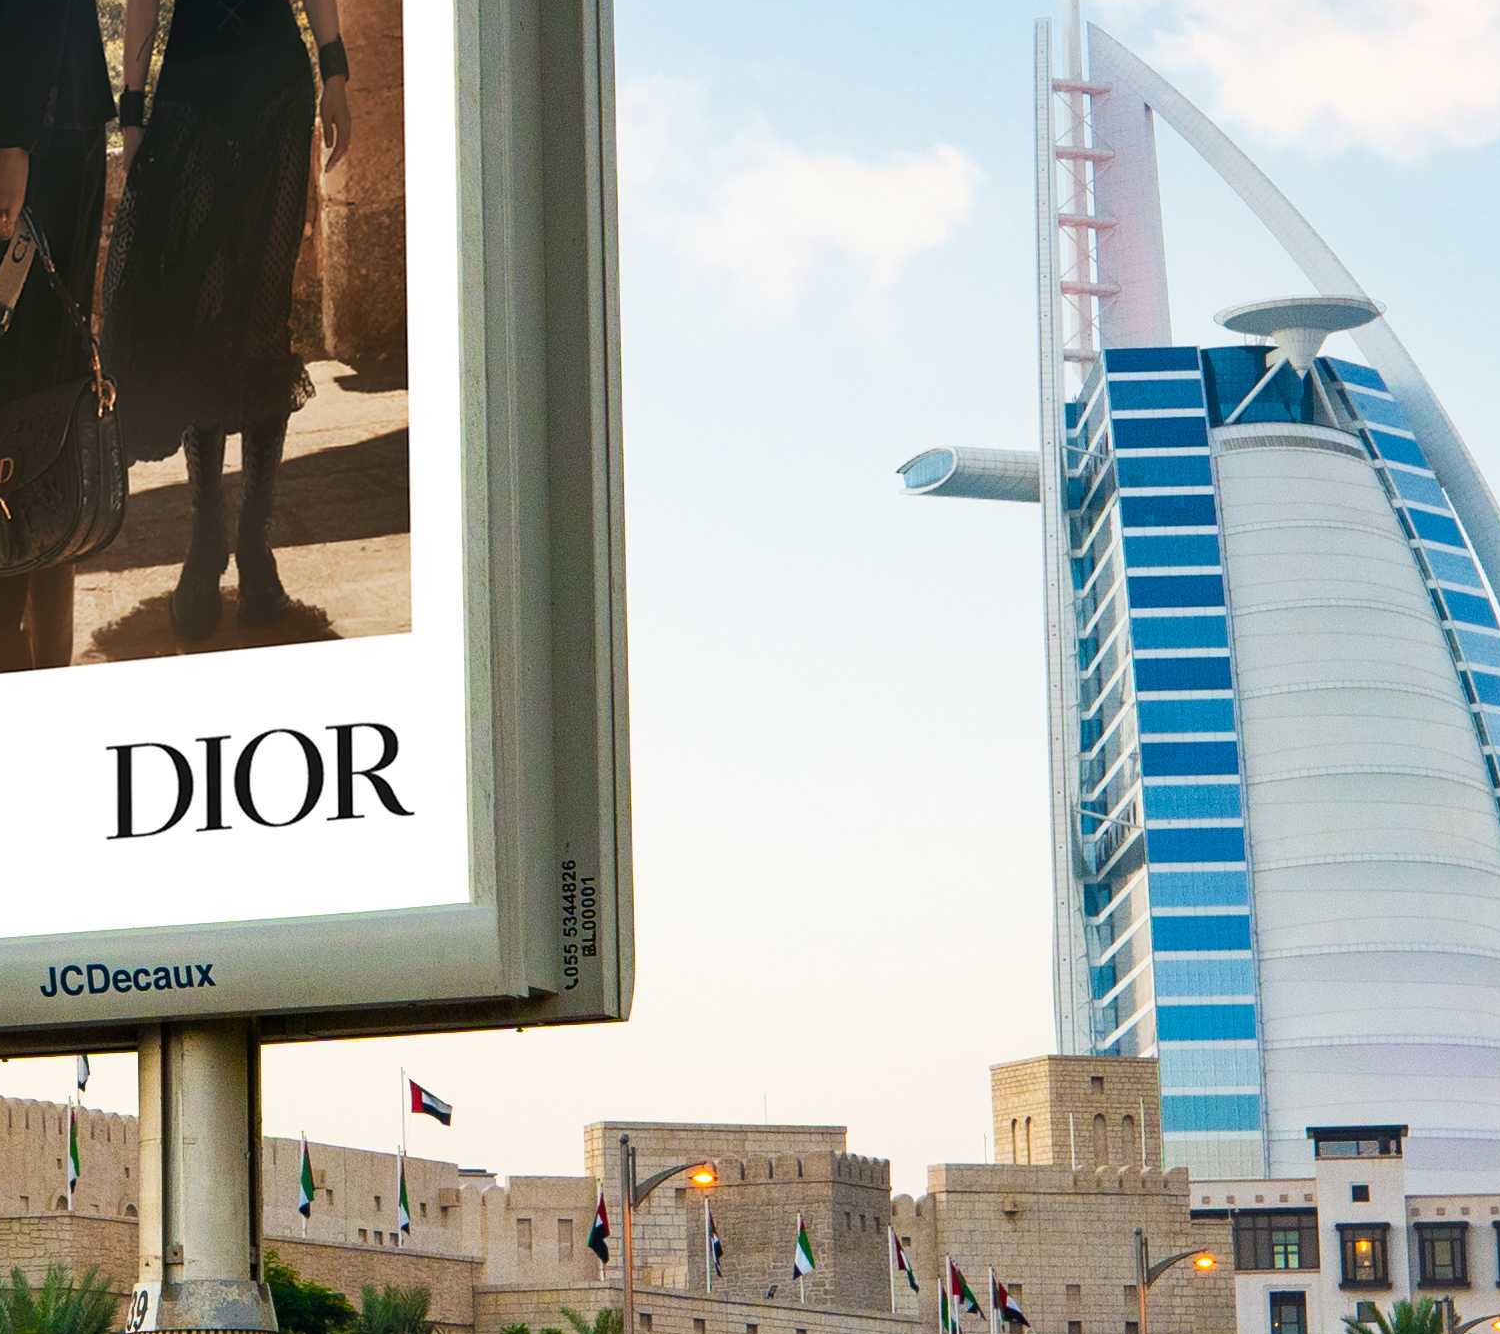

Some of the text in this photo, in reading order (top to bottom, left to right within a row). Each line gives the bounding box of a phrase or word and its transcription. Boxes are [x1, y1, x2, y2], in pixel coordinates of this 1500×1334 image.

[106, 722, 415, 840] DIOR
[562, 860, 579, 977] 055 5344826
[40, 963, 217, 998] JCDecaux
